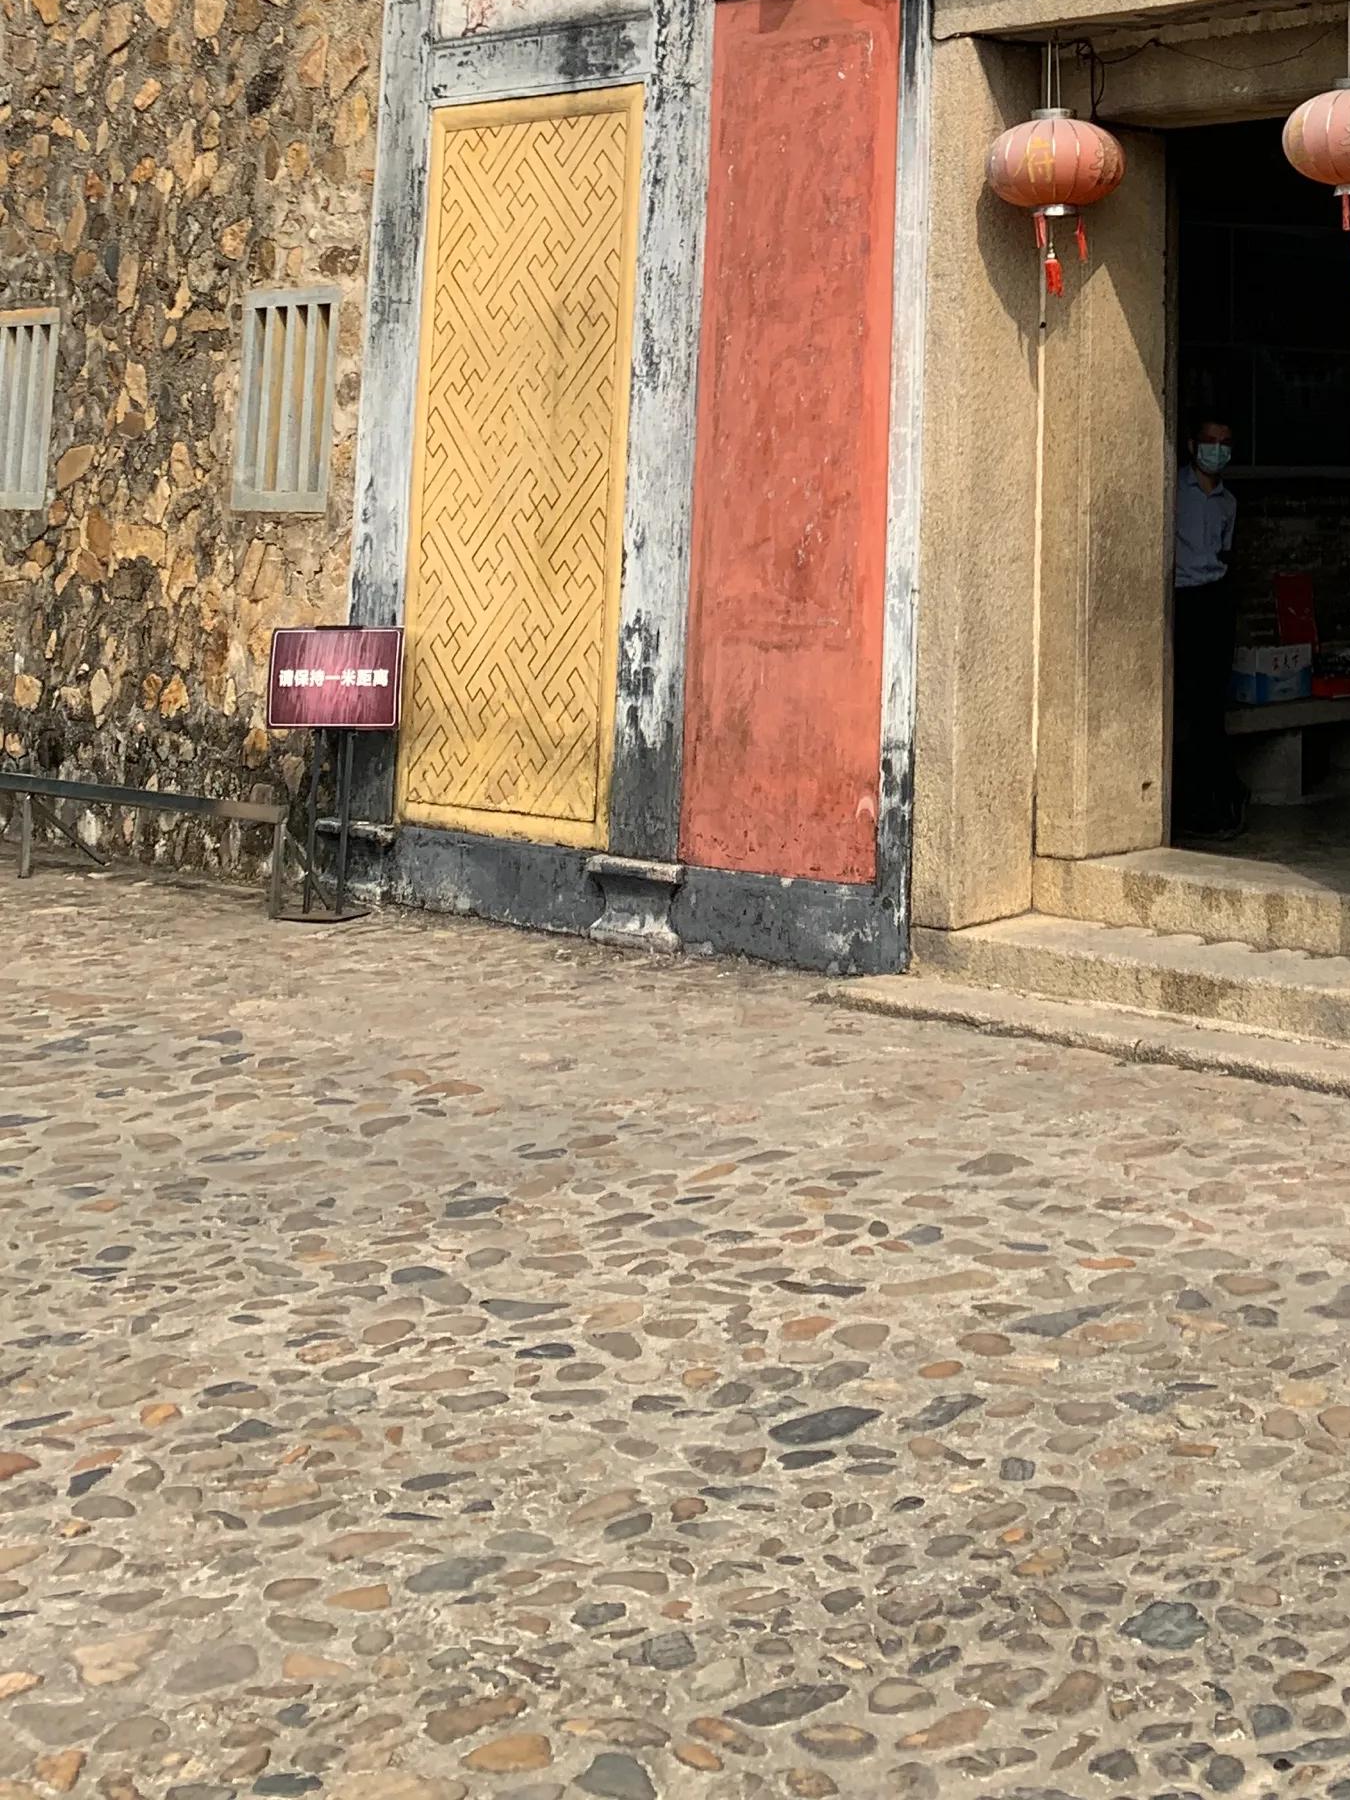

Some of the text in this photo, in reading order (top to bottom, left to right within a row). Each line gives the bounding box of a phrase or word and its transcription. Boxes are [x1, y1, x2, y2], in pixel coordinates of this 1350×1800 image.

[278, 668, 390, 688] 请保持一米距离
